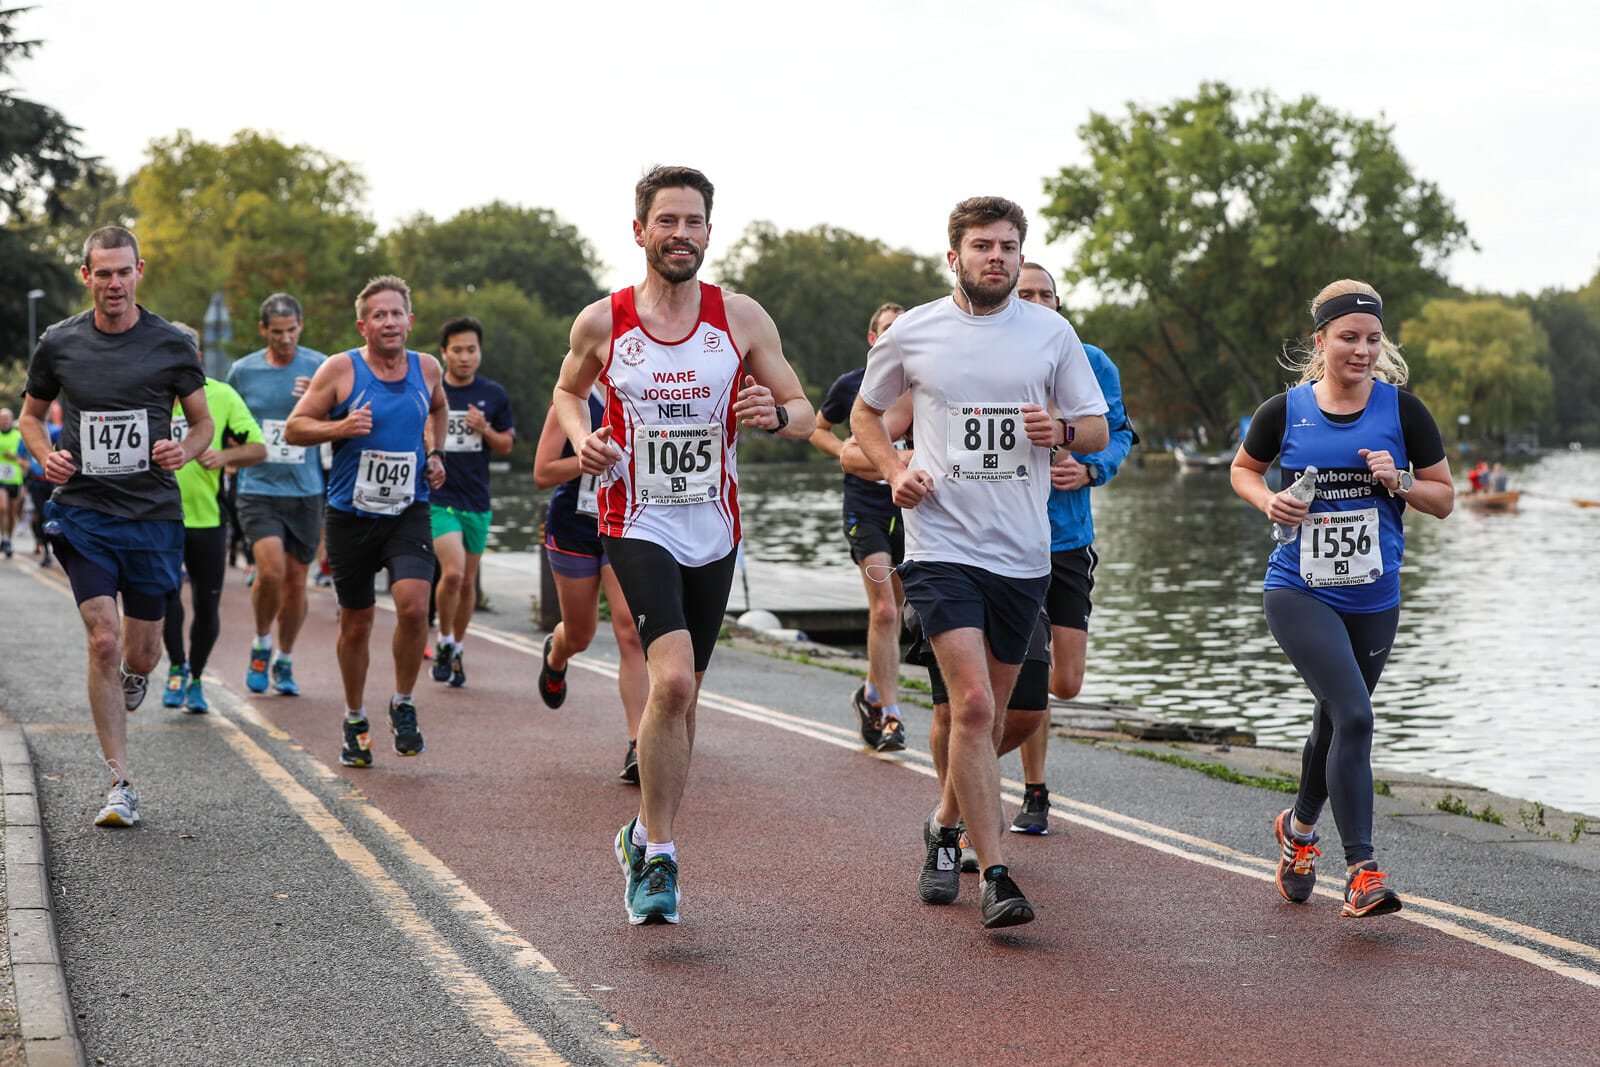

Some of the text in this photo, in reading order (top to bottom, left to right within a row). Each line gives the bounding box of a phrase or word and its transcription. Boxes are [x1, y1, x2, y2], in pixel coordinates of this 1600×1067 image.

[652, 370, 697, 384] WARE
[640, 386, 711, 401] JOGGERS
[658, 403, 699, 419] NEIL
[89, 423, 142, 450] 1476
[964, 418, 1016, 451] 818
[648, 440, 712, 475] 1065
[366, 460, 410, 486] 1049
[1315, 486, 1372, 500] Runners
[1312, 524, 1372, 559] 1556
